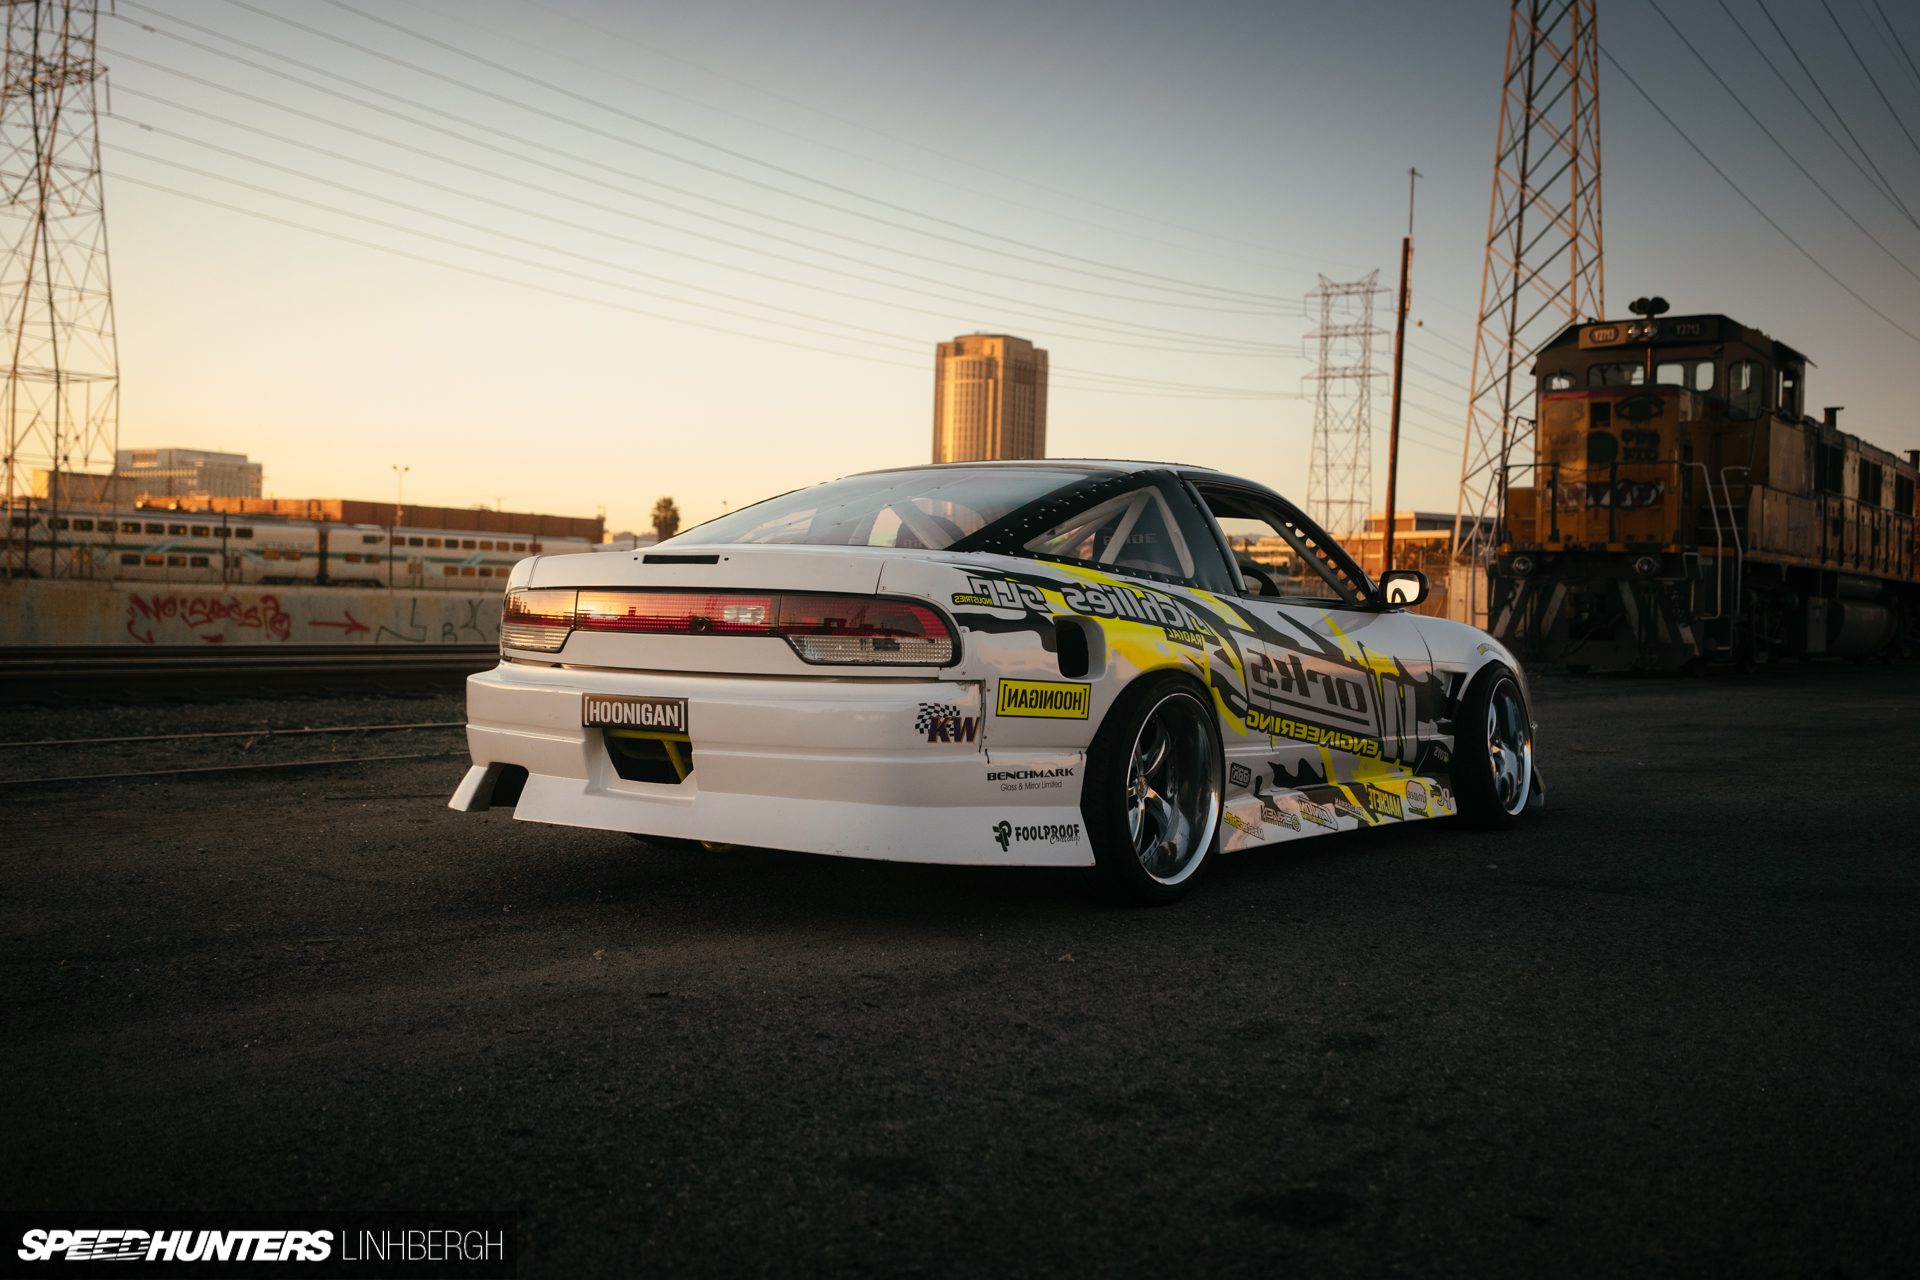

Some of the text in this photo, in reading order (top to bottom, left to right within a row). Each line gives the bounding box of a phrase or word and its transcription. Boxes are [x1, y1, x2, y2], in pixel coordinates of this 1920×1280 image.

[927, 716, 980, 743] KW
[987, 768, 1074, 781] BENCHMARK
[1000, 781, 1062, 791] Glass & Mirror Limited
[1014, 824, 1080, 842] FOOLPROOF
